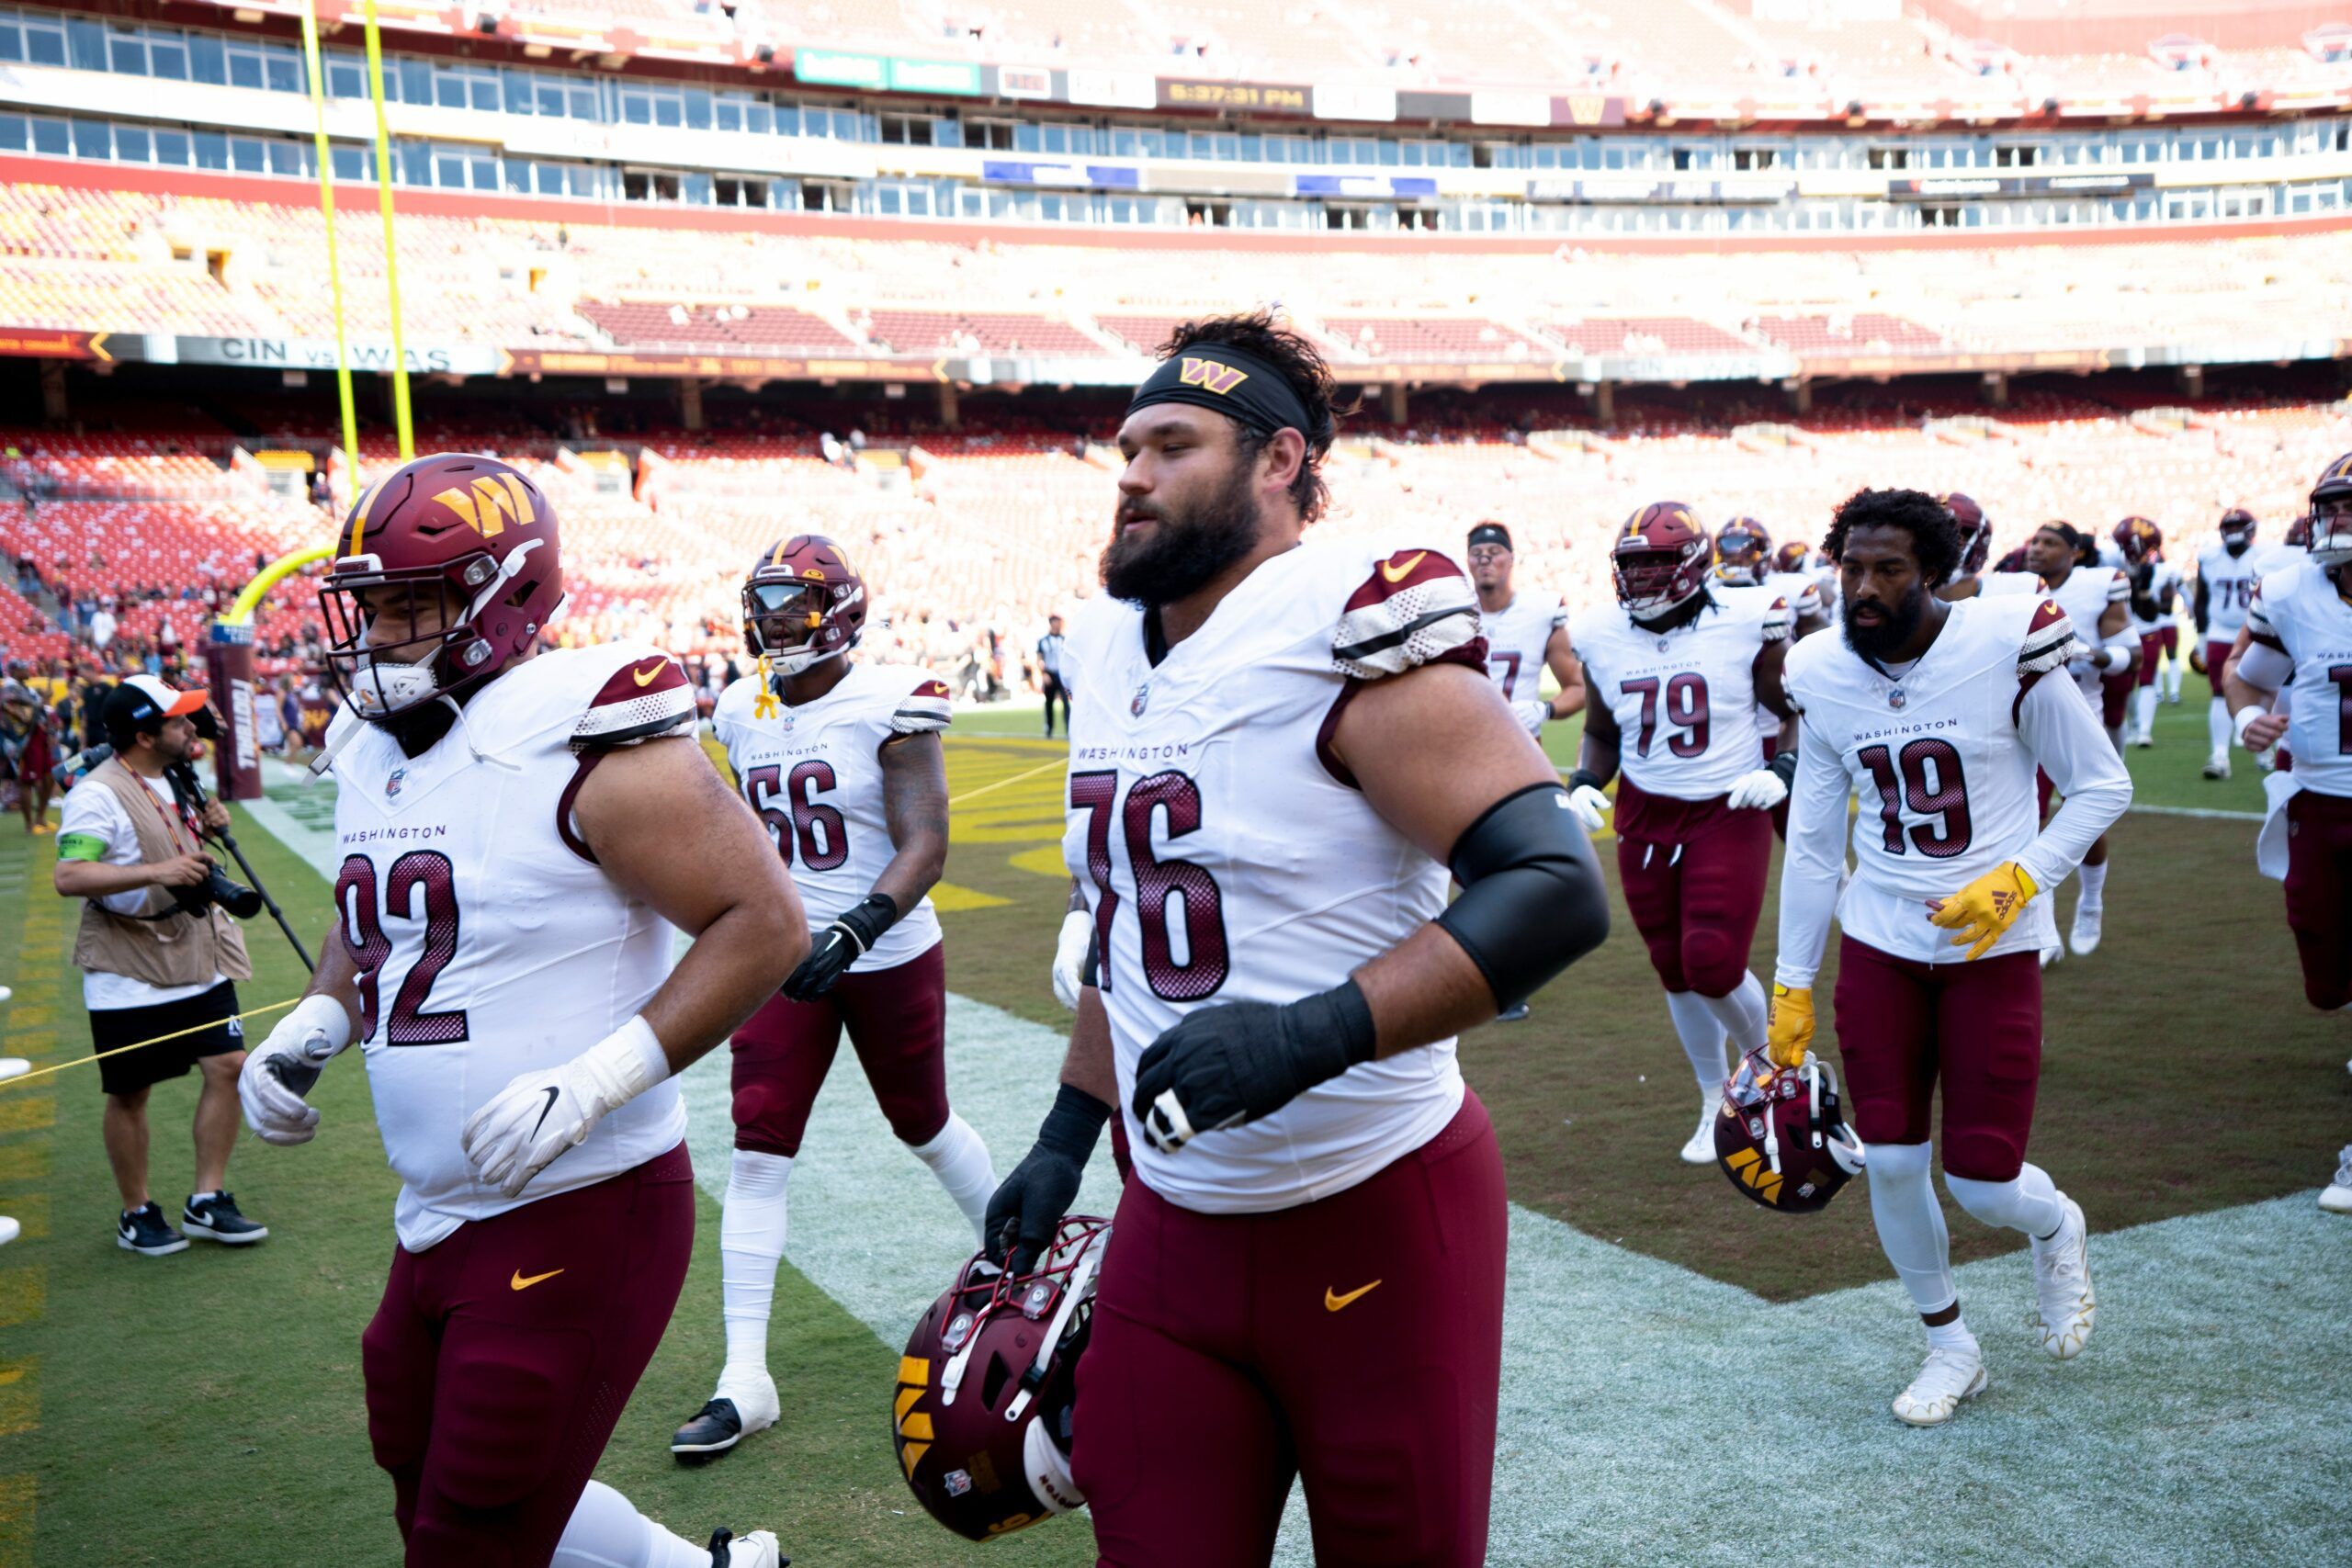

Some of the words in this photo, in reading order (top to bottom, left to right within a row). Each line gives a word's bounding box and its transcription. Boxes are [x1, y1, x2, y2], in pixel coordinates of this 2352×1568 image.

[1264, 89, 1304, 107] PM
[220, 338, 287, 360] CIN
[353, 345, 451, 371] WAS
[1625, 660, 1702, 676] WASHINGTON
[1620, 671, 1711, 759] 79
[1853, 718, 1958, 741] WASHINGTON
[751, 743, 829, 761] WASHINGTON
[1078, 743, 1189, 761] WASHINGTON
[1857, 738, 1973, 859] 19
[747, 760, 849, 872] 56
[343, 825, 447, 844] WASHINGTON
[1070, 769, 1230, 1002] 76
[1998, 890, 2018, 920] adidas
[334, 850, 470, 1047] 92
